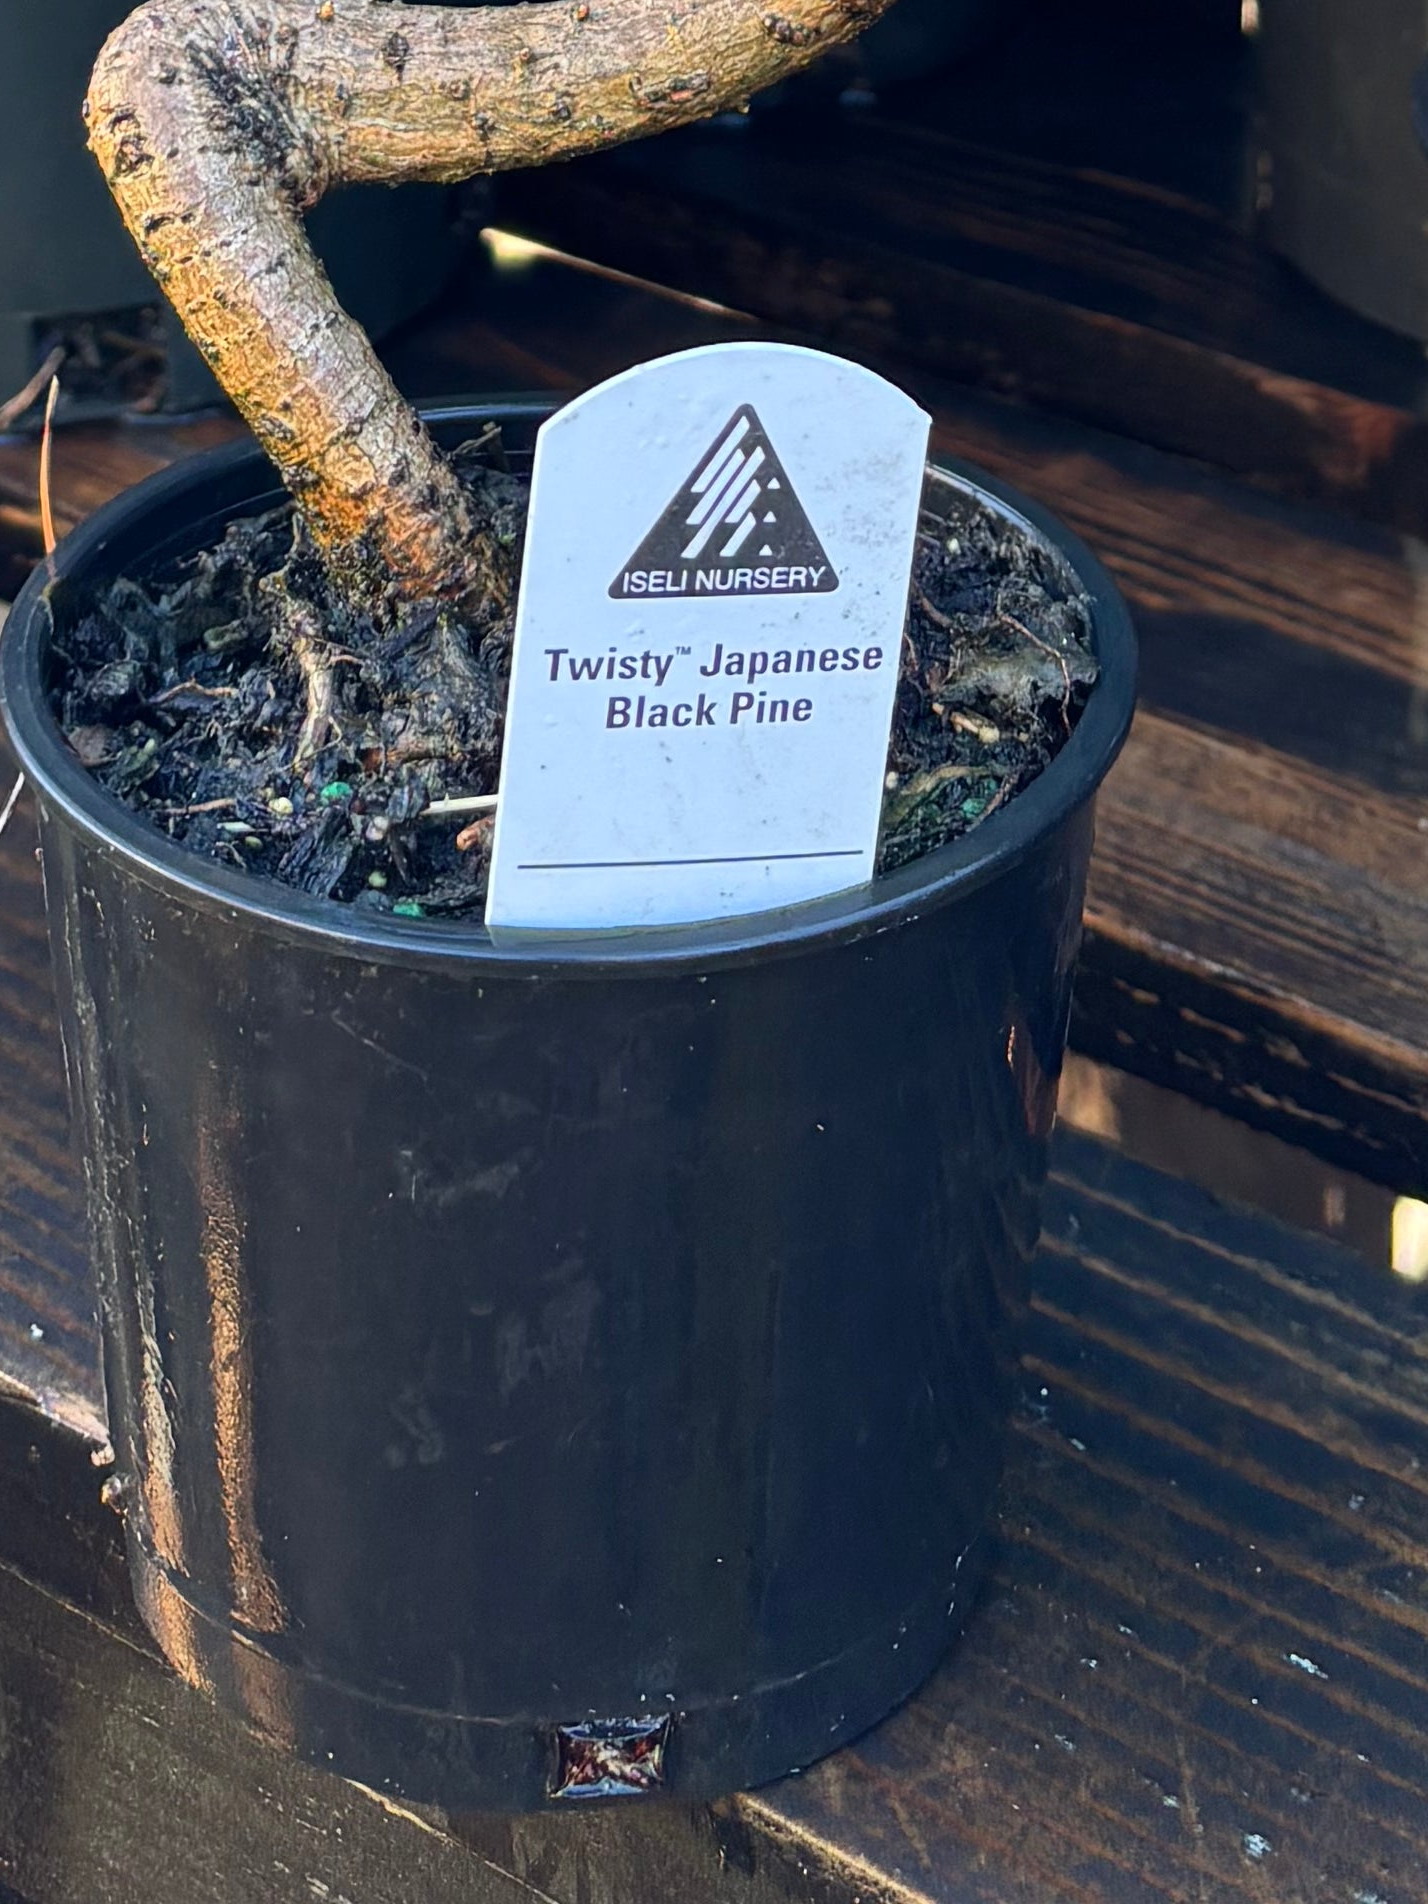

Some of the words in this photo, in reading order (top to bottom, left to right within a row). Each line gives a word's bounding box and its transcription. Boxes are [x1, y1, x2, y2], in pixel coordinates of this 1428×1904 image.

[622, 569, 687, 594] ISELI
[695, 565, 826, 591] NURSERY
[699, 643, 884, 684] Japanese
[605, 693, 718, 729] Black
[729, 691, 813, 725] Pine
